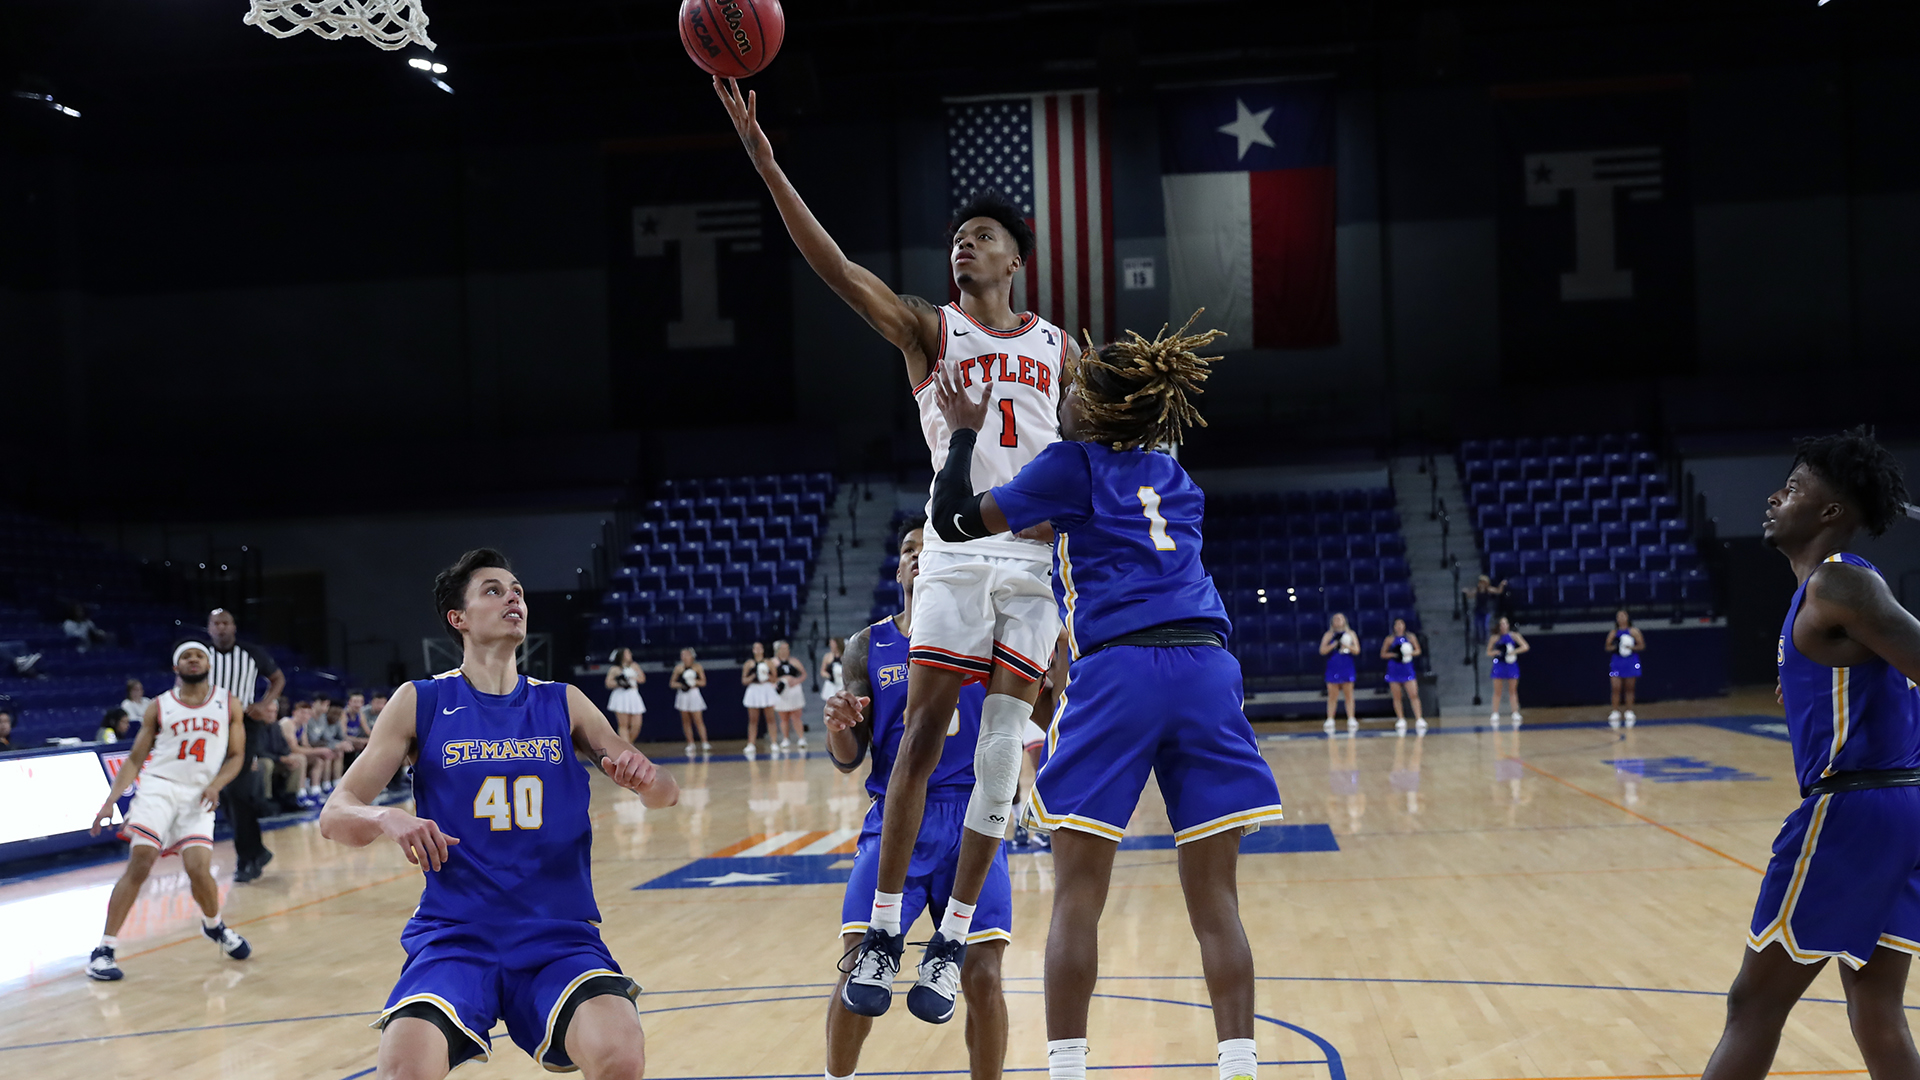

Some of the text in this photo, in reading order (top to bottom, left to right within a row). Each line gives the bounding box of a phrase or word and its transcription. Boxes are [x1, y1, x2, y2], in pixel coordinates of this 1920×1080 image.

[689, 7, 722, 58] NCAA
[1133, 271, 1147, 285] 15
[959, 352, 1052, 399] TYLER
[998, 398, 1018, 448] 1
[1136, 485, 1177, 551] 1
[878, 664, 909, 690] ST.
[170, 717, 220, 737] TYLER
[176, 738, 206, 762] 14
[473, 775, 543, 831] 40
